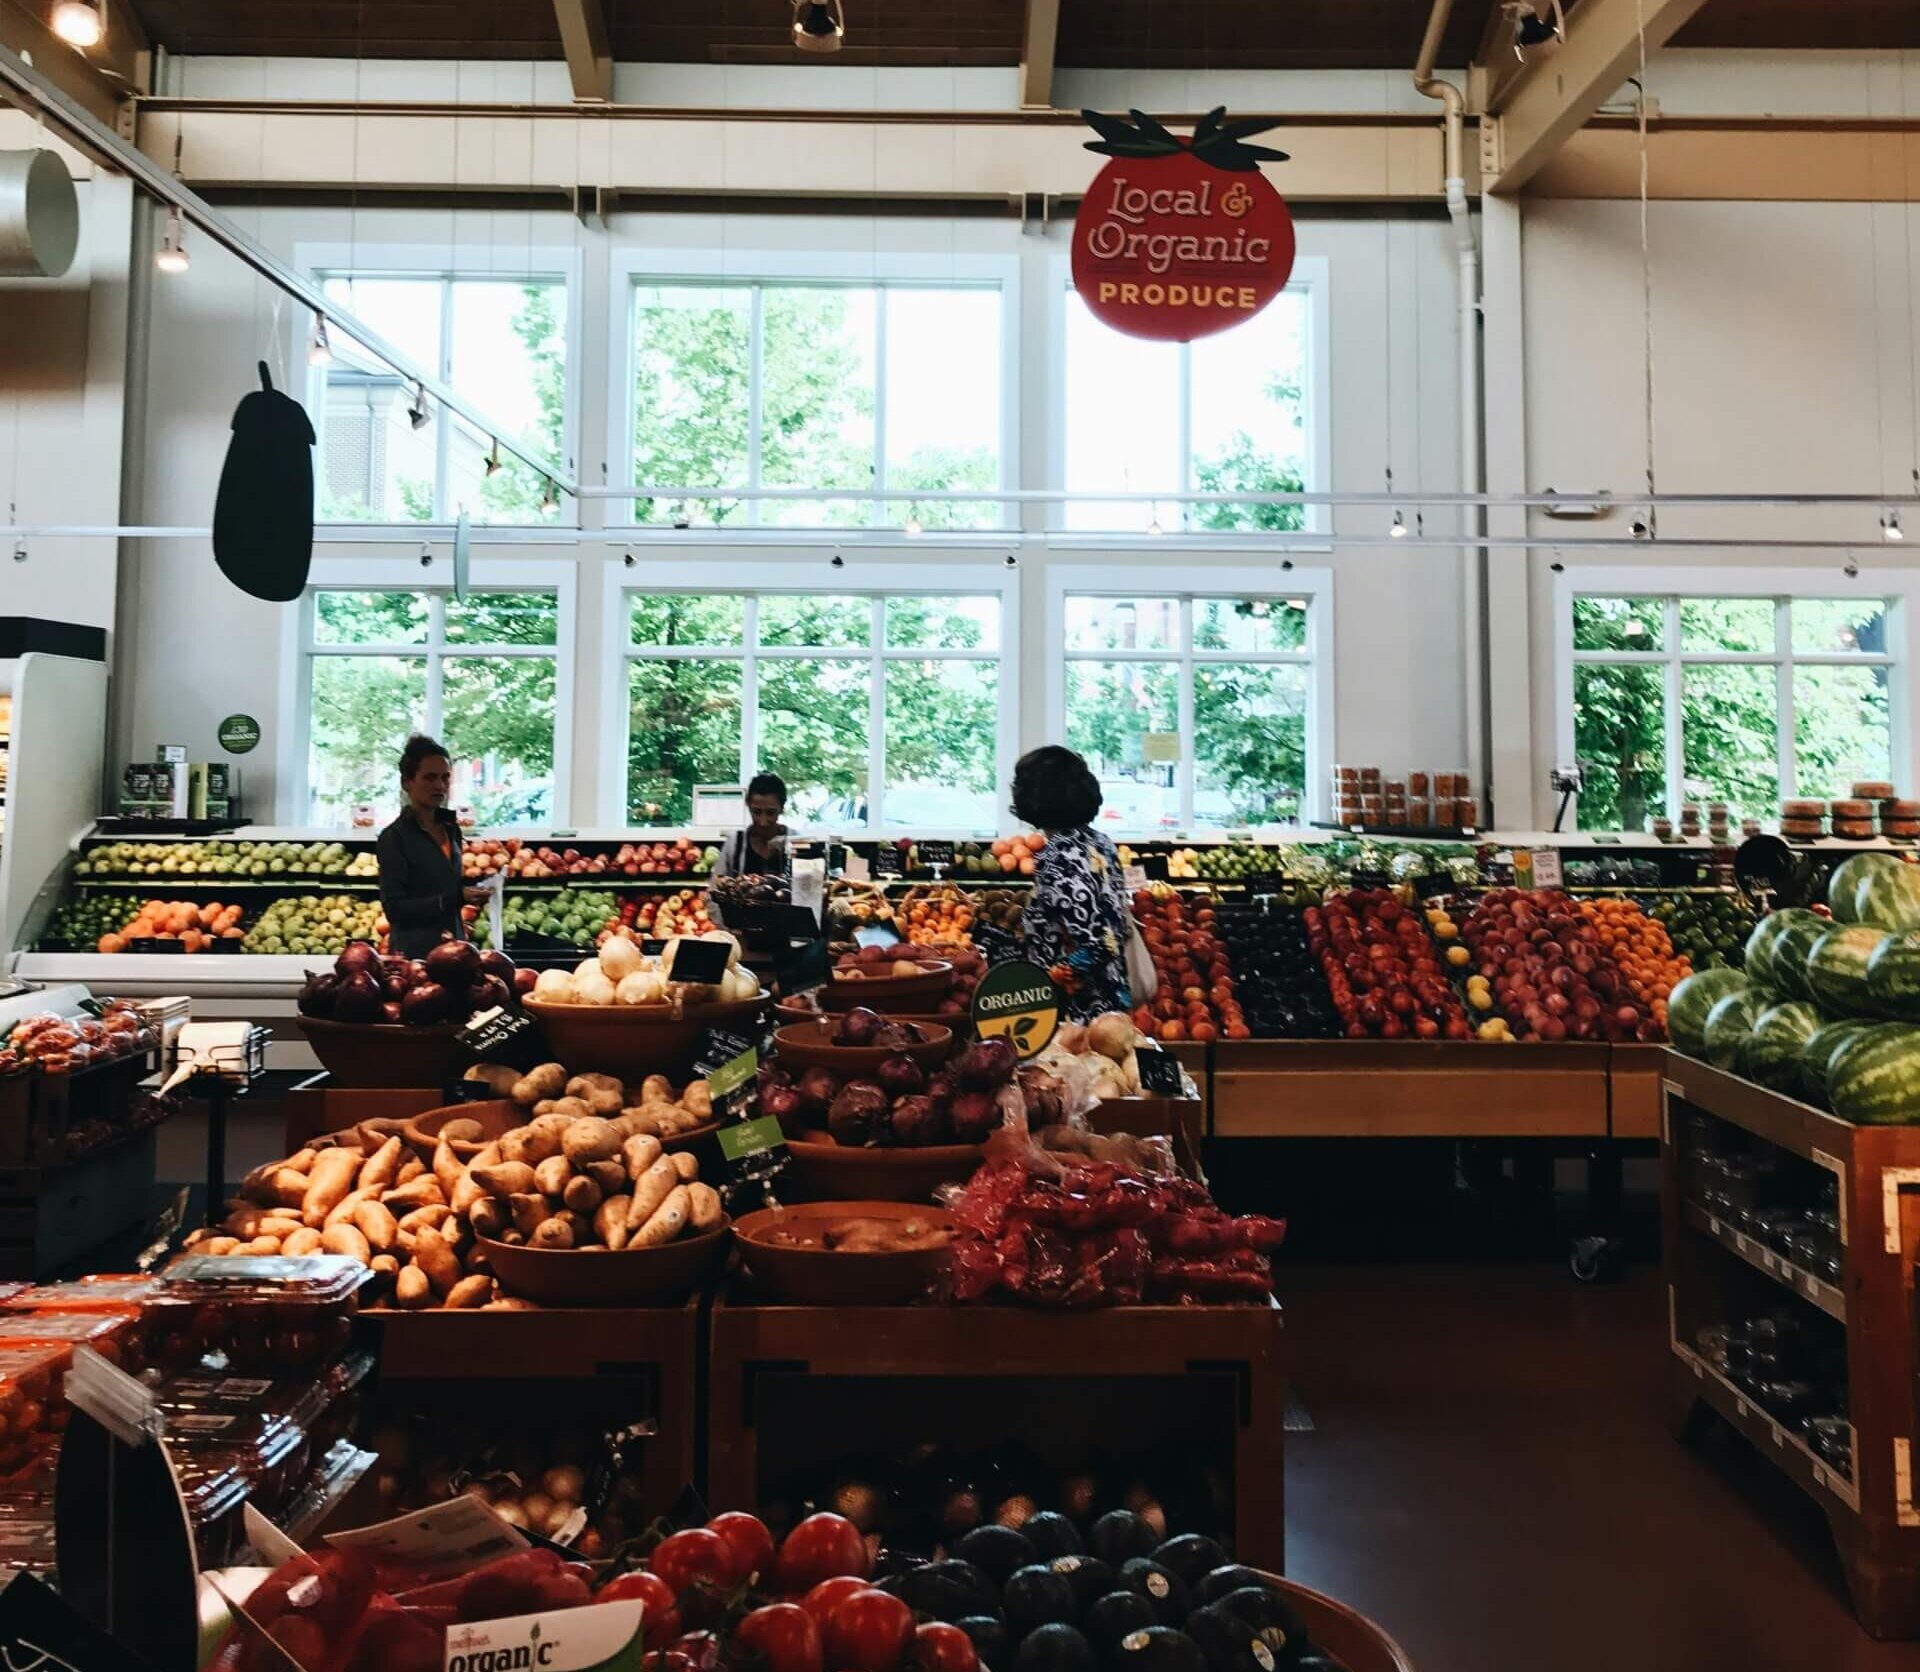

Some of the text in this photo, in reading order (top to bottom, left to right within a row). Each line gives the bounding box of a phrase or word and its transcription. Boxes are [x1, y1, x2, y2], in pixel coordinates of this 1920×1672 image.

[1107, 178, 1253, 224] Local &
[1088, 221, 1270, 274] Organic
[1099, 282, 1256, 308] PRODUCE
[979, 986, 1052, 1011] ORGANIC
